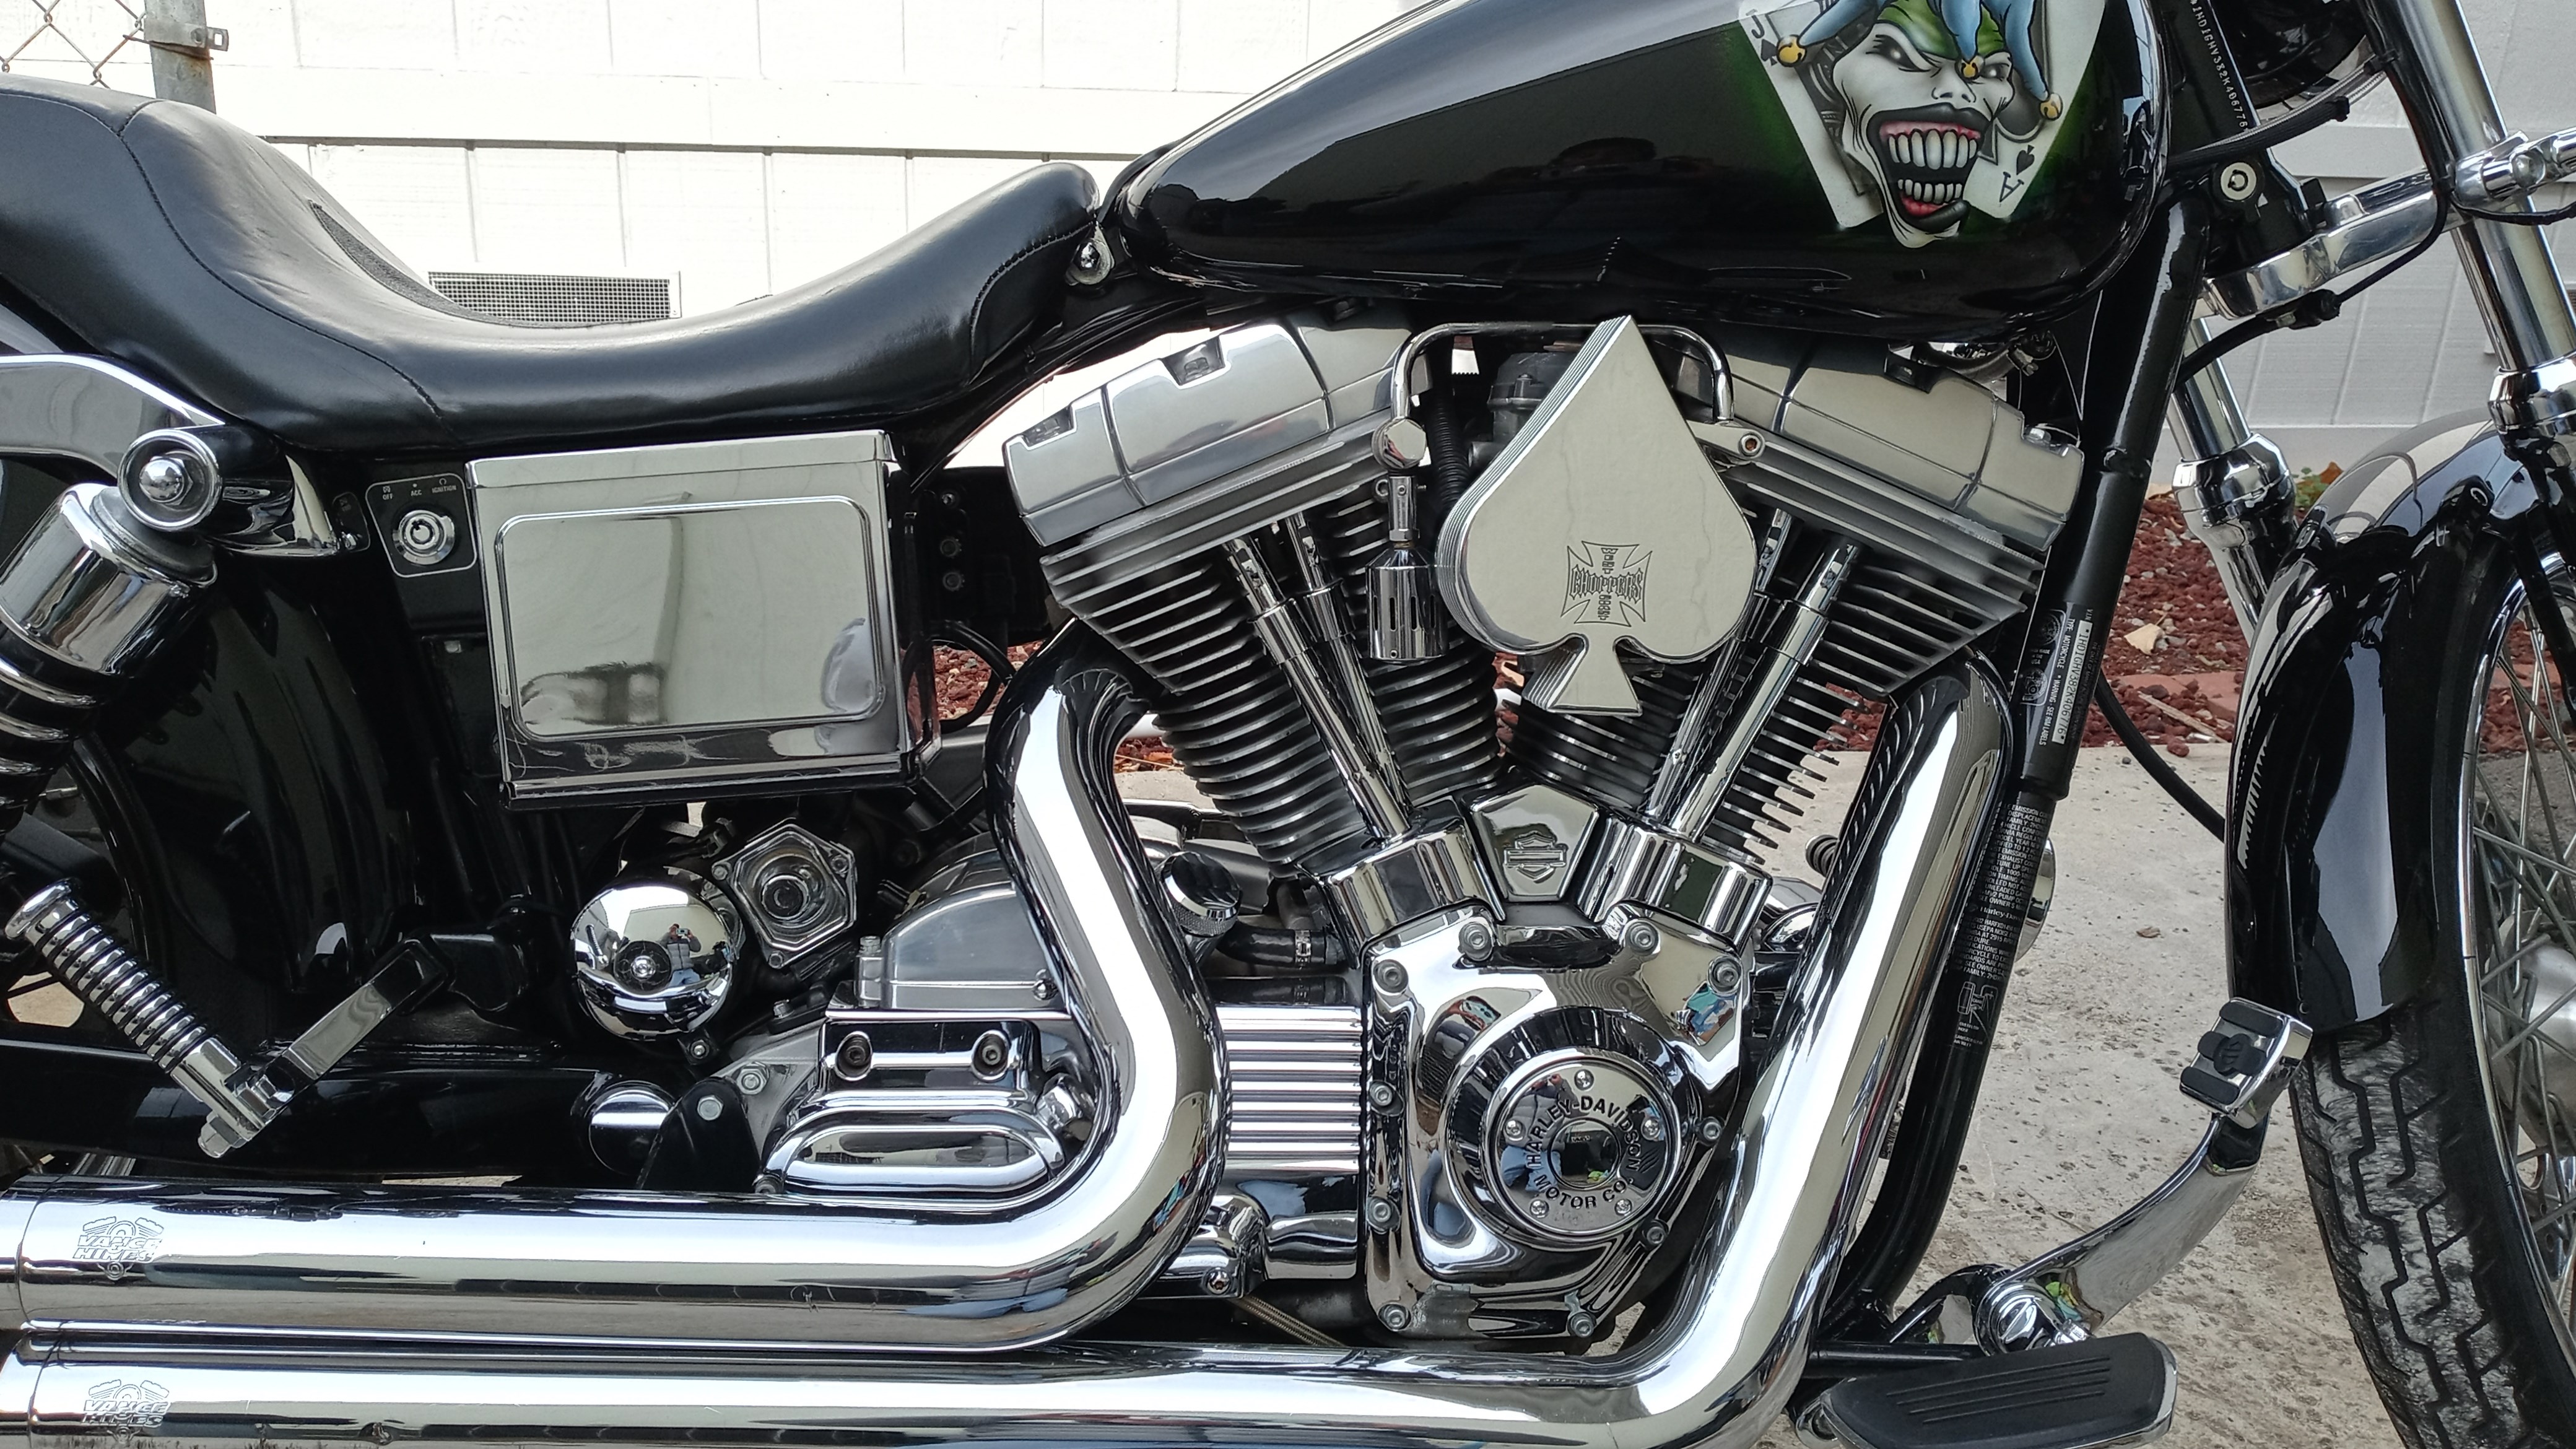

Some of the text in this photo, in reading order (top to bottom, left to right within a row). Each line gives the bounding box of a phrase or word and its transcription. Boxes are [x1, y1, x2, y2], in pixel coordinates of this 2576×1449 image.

[432, 485, 457, 494] IGNITION
[2056, 635, 2071, 669] MOTORCYCLE
[2050, 679, 2061, 703] WARNING
[2045, 705, 2055, 716] SEE
[2038, 726, 2050, 746] LABELS
[2011, 804, 2039, 816] EMISSION
[2014, 843, 2022, 851] TO
[1997, 853, 2024, 864] EXHAUST
[2001, 848, 2027, 859] EMISSION
[1996, 859, 2012, 868] TUNE
[1985, 883, 2016, 895] UNLEADED
[2007, 882, 2020, 890] NOT
[1998, 892, 2016, 902] PUMP
[1526, 1096, 1642, 1170] HARLEY-DAVIDSON
[1534, 1174, 1634, 1209] MOTOR CO.
[77, 1234, 163, 1249] VANCE
[72, 1247, 155, 1262] HINES
[84, 1399, 171, 1416] VANCE
